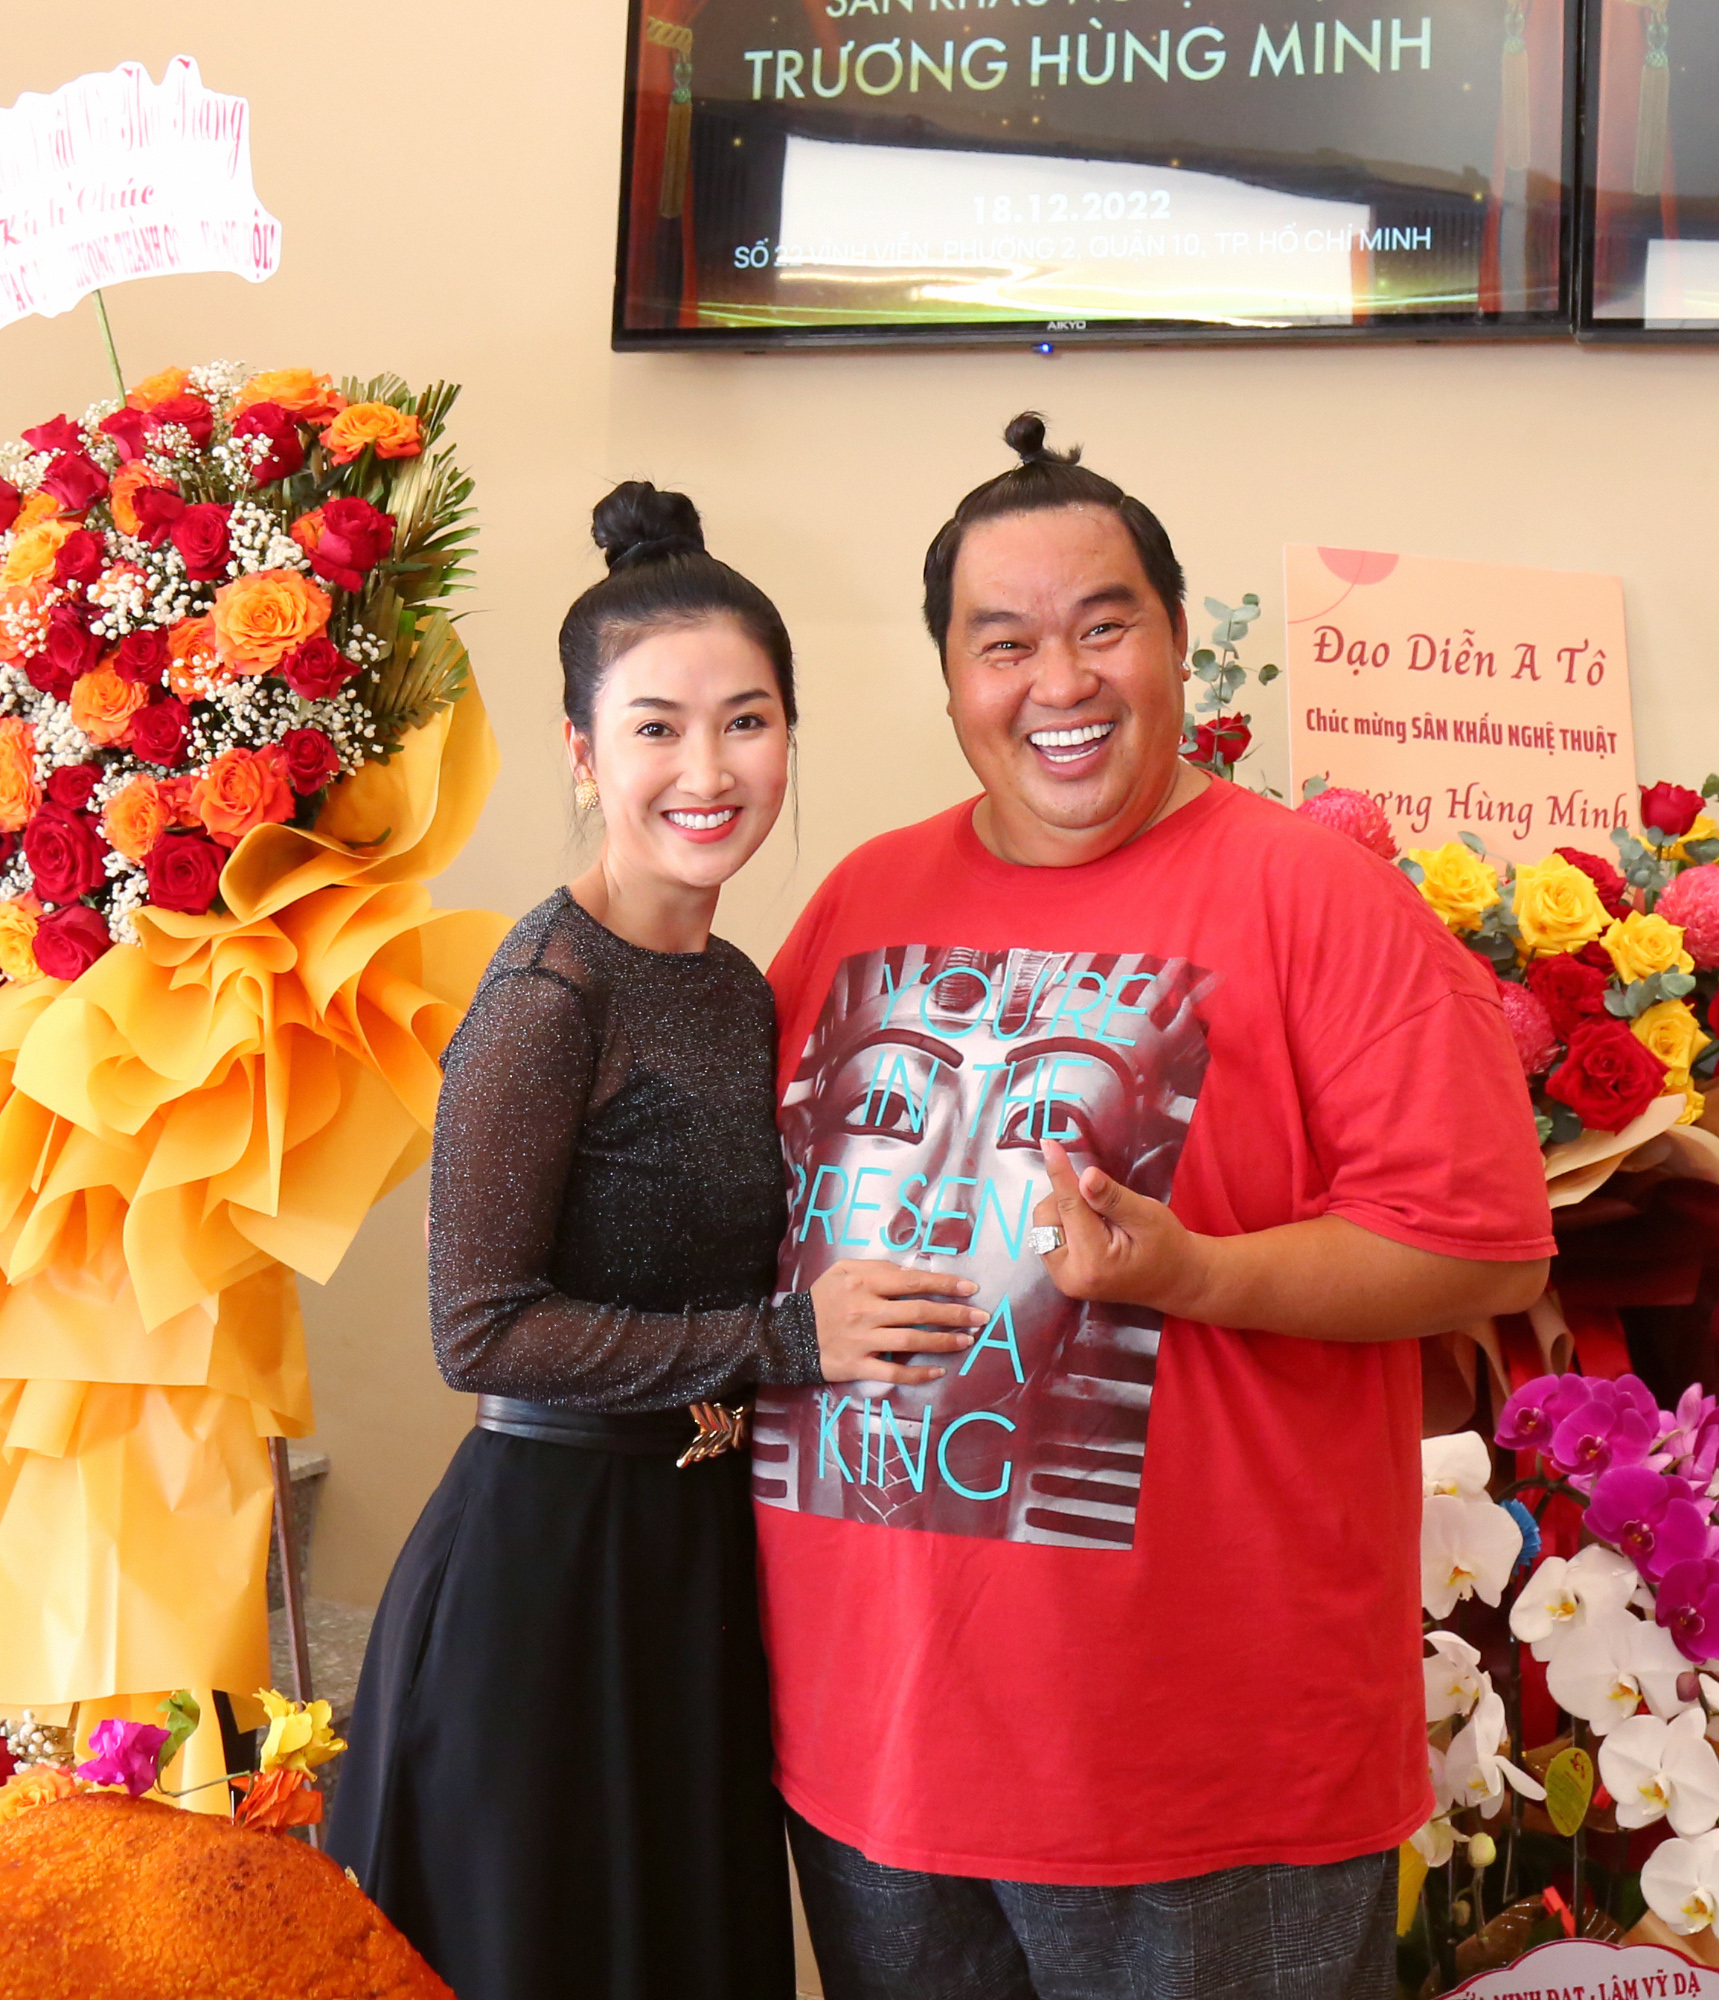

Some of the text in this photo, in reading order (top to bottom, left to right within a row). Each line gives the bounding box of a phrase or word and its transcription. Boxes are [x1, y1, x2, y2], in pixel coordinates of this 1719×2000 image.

[744, 17, 1431, 100] TRƯƠNG HÙNG MINH
[972, 189, 1171, 225] 18.12.2022
[734, 237, 770, 269] SỐ
[1358, 227, 1431, 251] MINH
[1046, 320, 1087, 331] AIKYO
[1313, 625, 1607, 686] Đạo Diễn A Tô
[1306, 707, 1618, 760] Chúc mừng SÂN KHẤU NGHỆ THUẬT
[1445, 782, 1534, 840] Hùng
[1547, 789, 1631, 831] Minh
[878, 963, 1159, 1047] YOU'RE
[860, 1052, 1094, 1140] IN THE
[958, 1292, 1026, 1384] A
[818, 1393, 1018, 1501] KING
[1673, 1971, 1701, 1998] DẠ
